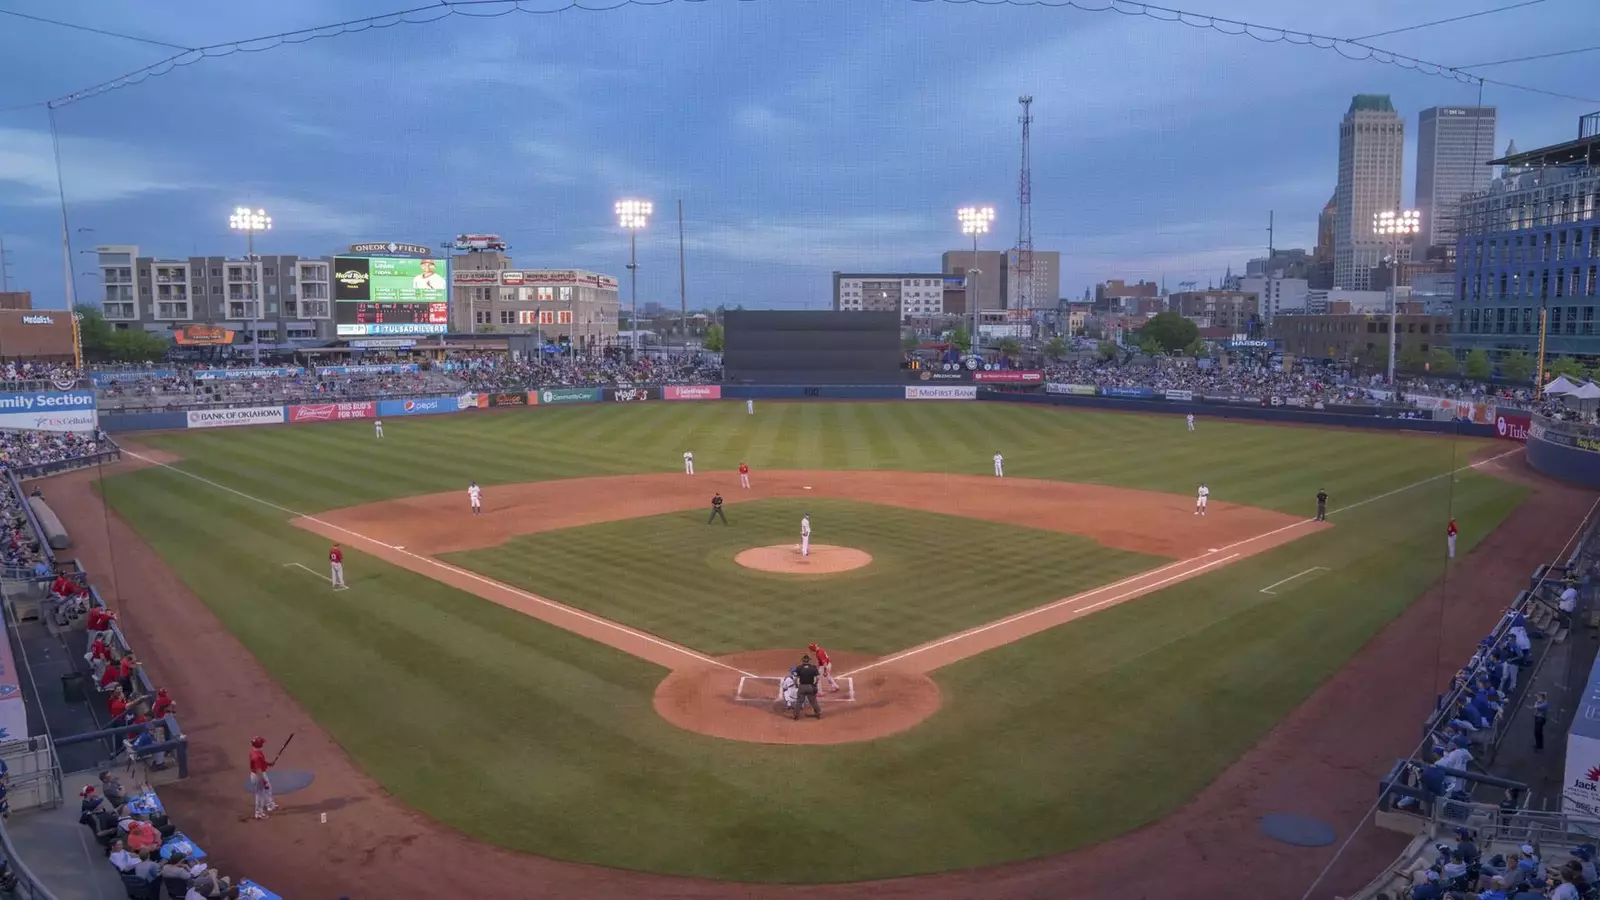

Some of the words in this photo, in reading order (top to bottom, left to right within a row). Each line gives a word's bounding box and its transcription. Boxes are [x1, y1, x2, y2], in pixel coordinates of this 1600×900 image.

[356, 244, 386, 252] ONEOK
[398, 245, 426, 254] FIELD
[36, 394, 92, 407] Section
[353, 402, 371, 410] BUD'S
[416, 401, 437, 411] pepsi
[201, 412, 224, 420] BANK
[238, 410, 281, 418] OKLAHOMA
[1508, 424, 1529, 439] Tuls
[1574, 779, 1597, 791] Jack
